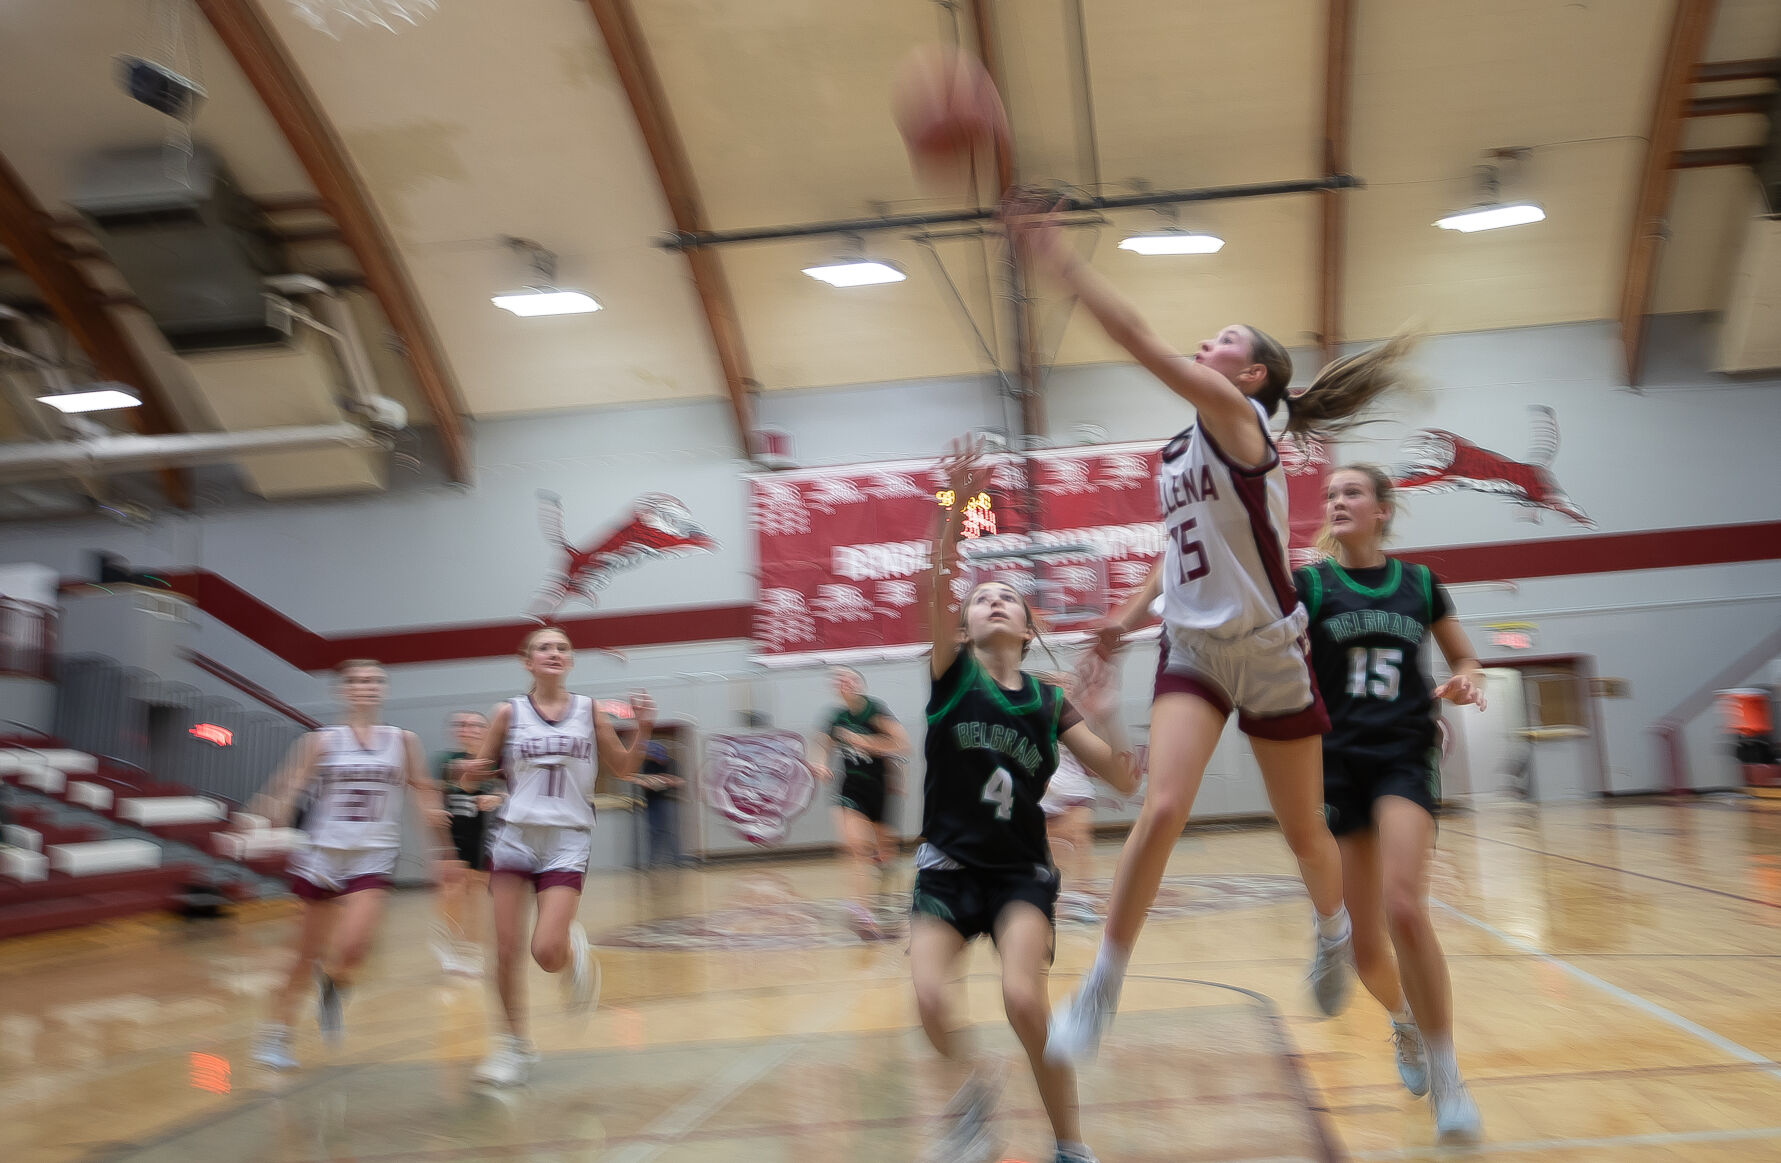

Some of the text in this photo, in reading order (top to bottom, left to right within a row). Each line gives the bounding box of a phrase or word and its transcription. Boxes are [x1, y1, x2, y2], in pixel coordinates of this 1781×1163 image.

[1160, 464, 1220, 518] LENA
[1170, 517, 1211, 585] 15
[1345, 646, 1403, 700] 15
[982, 766, 1014, 820] 4
